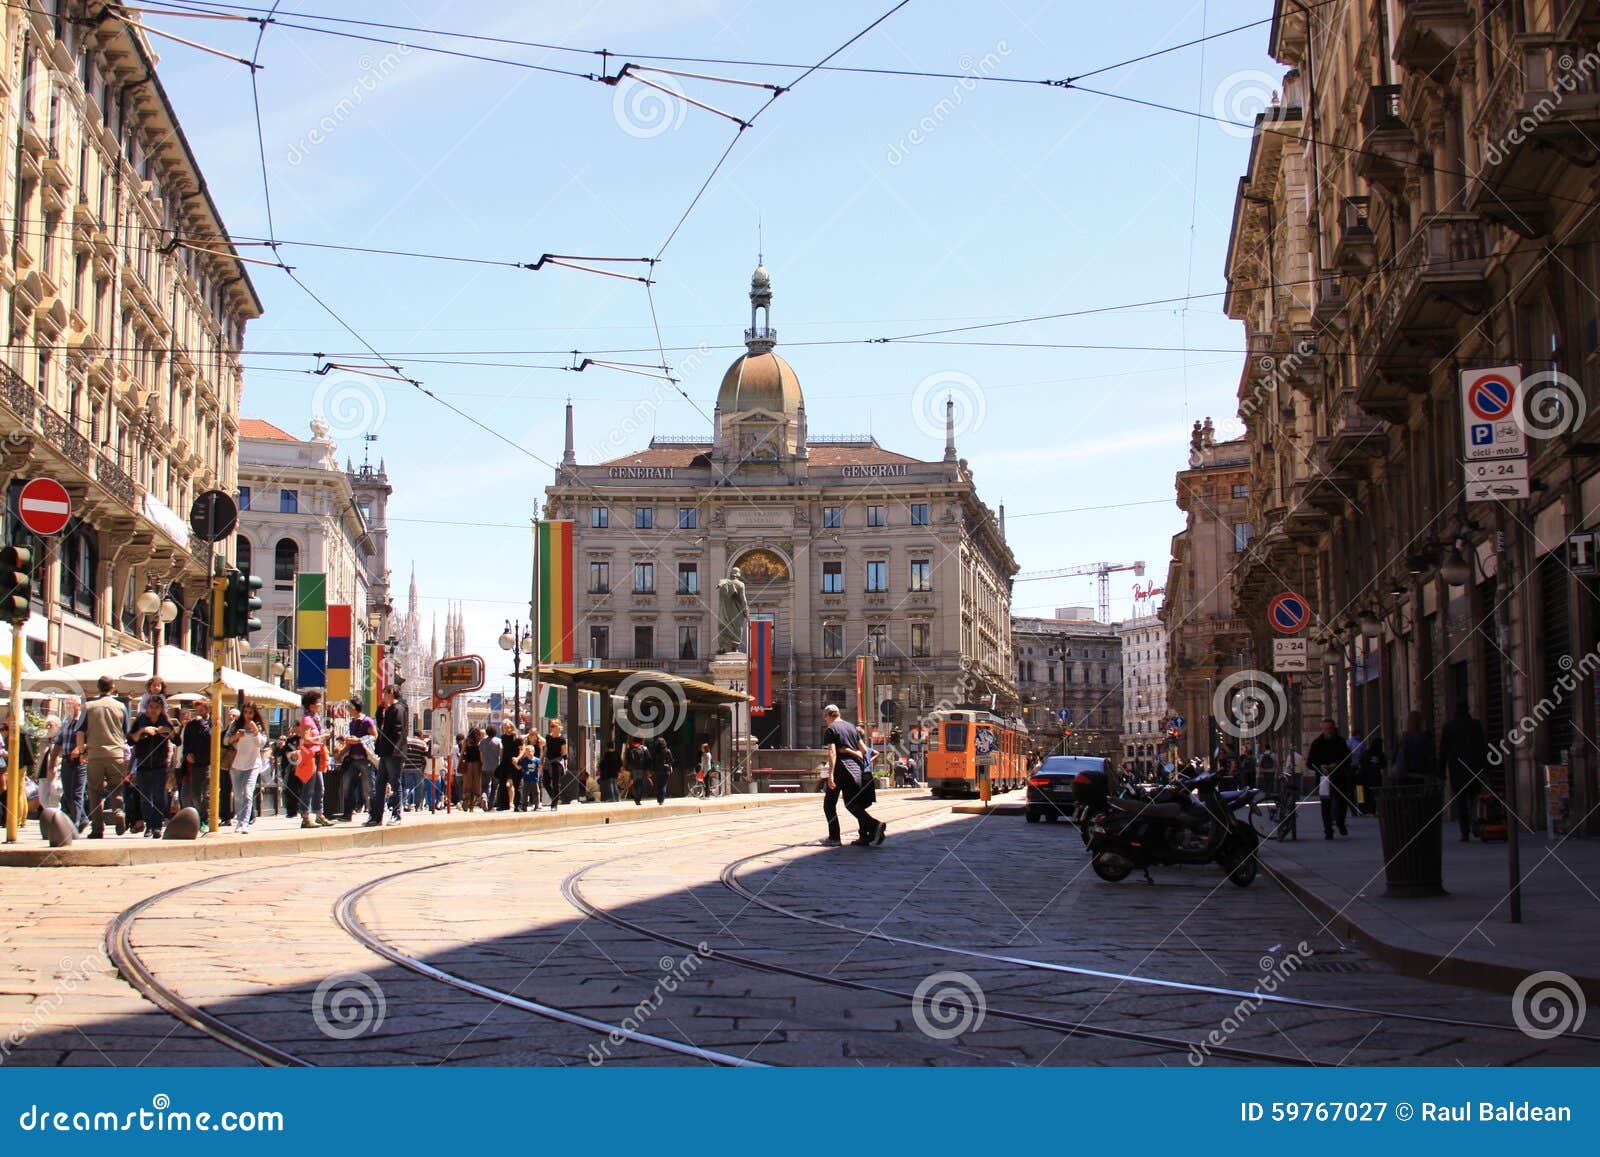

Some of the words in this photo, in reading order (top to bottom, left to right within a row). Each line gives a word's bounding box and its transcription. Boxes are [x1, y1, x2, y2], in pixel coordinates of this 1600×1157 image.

[1475, 426, 1490, 443] P
[608, 466, 675, 480] GENERALI
[841, 464, 908, 477] GENERALI
[1569, 534, 1592, 564] T
